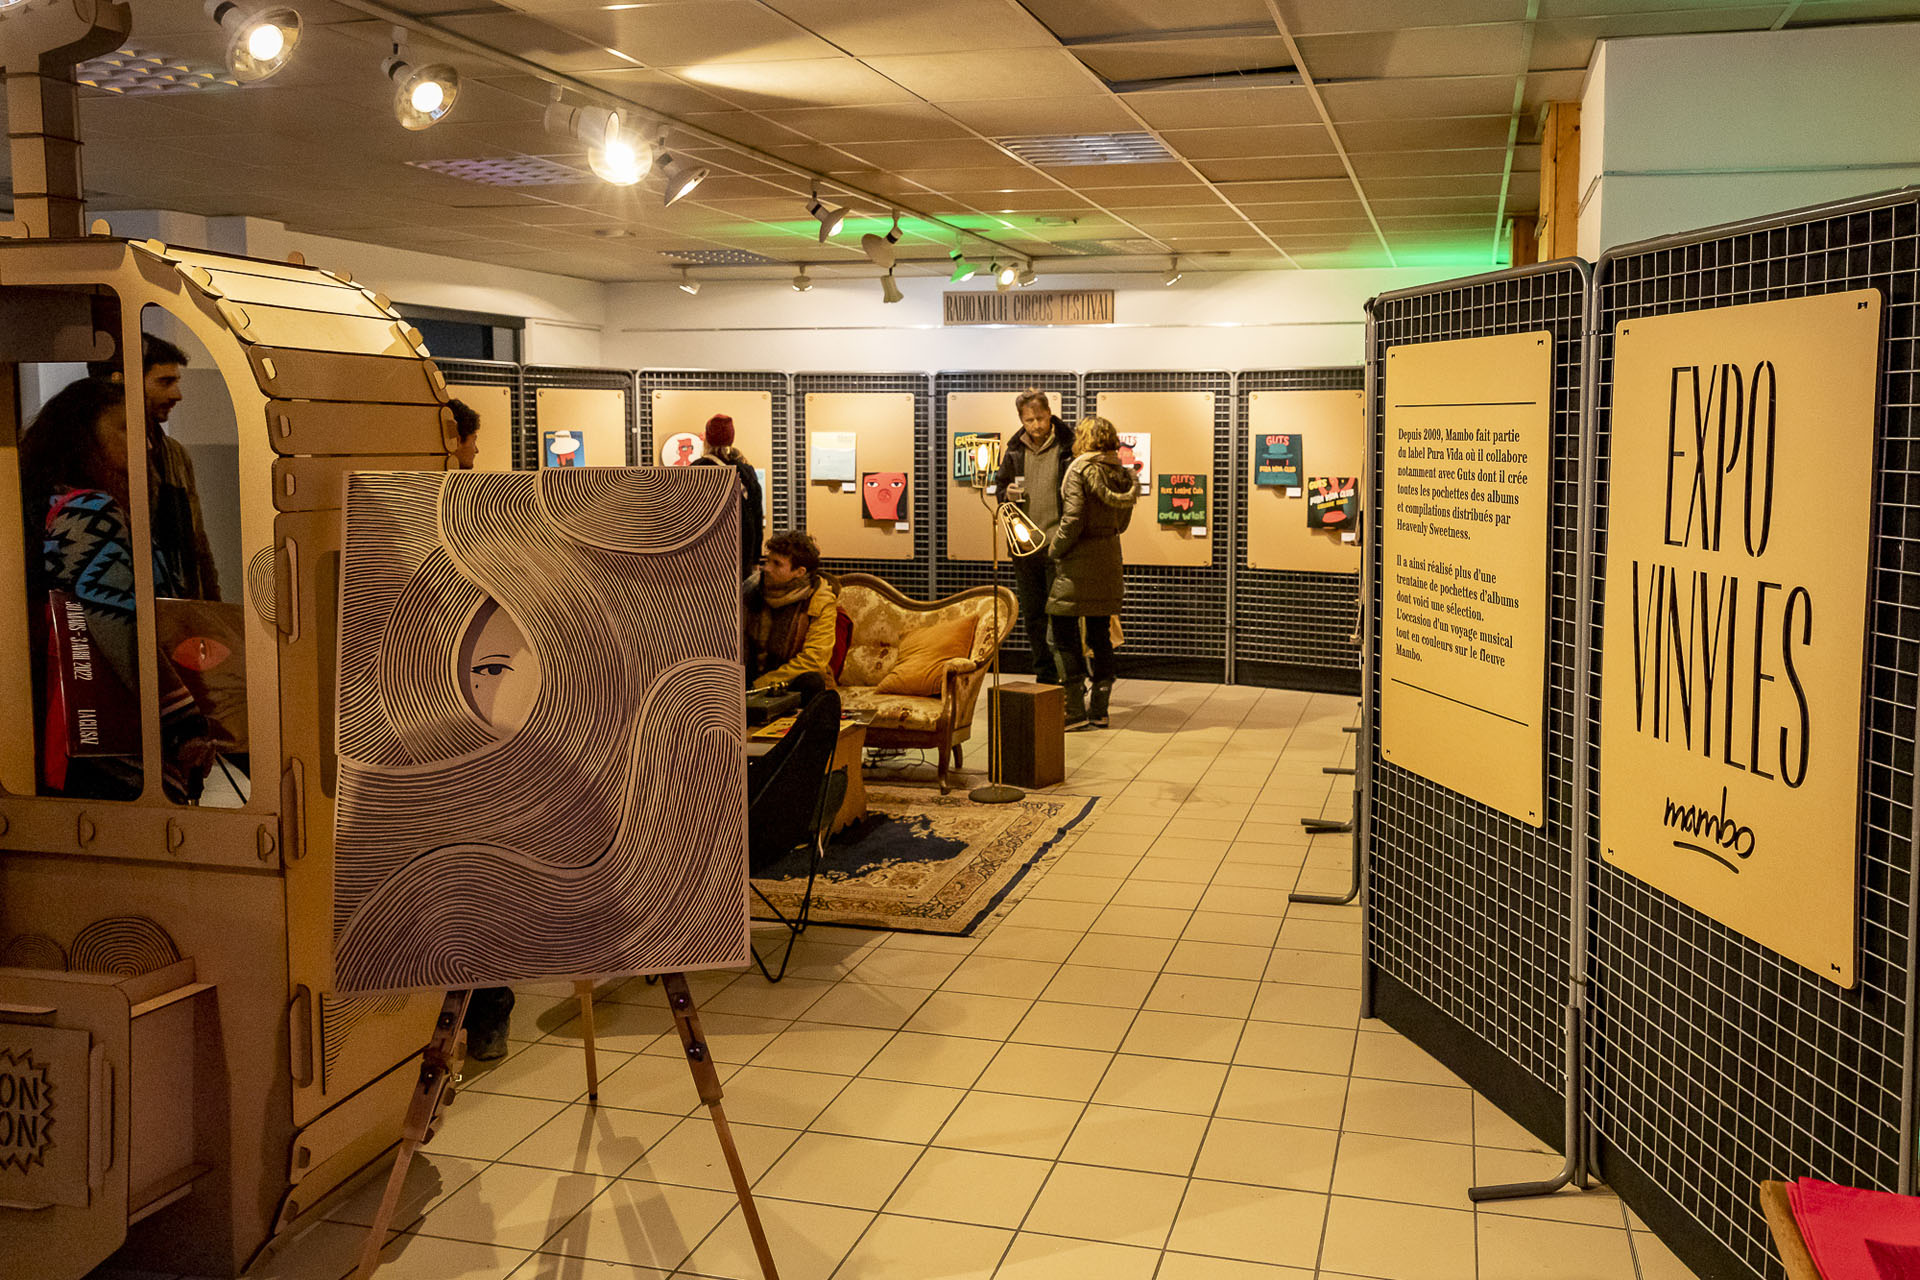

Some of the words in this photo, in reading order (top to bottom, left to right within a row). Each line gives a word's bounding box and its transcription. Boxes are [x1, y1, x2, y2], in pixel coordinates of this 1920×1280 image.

[946, 295, 975, 322] RADIO
[1013, 294, 1053, 321] CIRCUS
[1265, 435, 1290, 447] GUTS
[1398, 428, 1422, 443] Depuis
[1423, 428, 1444, 443] 2009,
[1445, 428, 1474, 441] Mambo
[1476, 428, 1491, 442] fait
[1493, 429, 1520, 445] partie
[1398, 447, 1406, 458] du
[1408, 447, 1425, 459] label
[1427, 447, 1444, 460] Pura
[1446, 448, 1463, 461] Vida
[1465, 448, 1475, 461] où
[1477, 449, 1484, 461] il
[1486, 449, 1528, 463] collabore
[1664, 360, 1778, 558] EXPO
[1170, 475, 1195, 485] GUTS
[1397, 466, 1436, 478] notamment
[1438, 469, 1455, 479] avec
[1457, 467, 1476, 481] Guts
[1477, 468, 1497, 483] dont
[1499, 469, 1505, 483] il
[1507, 470, 1528, 485] crée
[1397, 483, 1419, 495] toutes
[1420, 484, 1430, 497] les
[1432, 486, 1469, 500] pochettes
[1470, 488, 1485, 502] des
[1487, 490, 1519, 505] albums
[1397, 502, 1404, 513] et
[1405, 503, 1451, 518] compilations
[1452, 506, 1494, 523] distribués
[1495, 513, 1511, 527] par
[1397, 518, 1428, 536] Heavenly
[1429, 522, 1471, 540] Sweetness.
[1396, 554, 1402, 566] Il
[1403, 559, 1408, 567] a
[1409, 557, 1426, 571] ainsi
[1427, 560, 1453, 576] réalisé
[1454, 565, 1472, 580] plus
[1396, 573, 1428, 590] trentaine
[1429, 579, 1438, 592] de
[1440, 584, 1478, 600] pochettes
[65, 601, 84, 611] 30
[1396, 590, 1411, 604] dont
[1413, 595, 1429, 609] voici
[1431, 601, 1444, 612] une
[1446, 602, 1484, 622] sélection.
[67, 611, 87, 631] MARS
[1396, 626, 1410, 640] tout
[1411, 632, 1420, 643] en
[1421, 635, 1453, 652] couleurs
[1454, 644, 1468, 657] sur
[1470, 645, 1478, 659] le
[1479, 648, 1505, 667] fleuve
[1450, 624, 1478, 642] voyage
[1479, 631, 1513, 649] musical
[71, 643, 91, 660] AVRIL
[1395, 643, 1423, 662] Mambo.
[73, 661, 93, 681] 2022
[1632, 560, 1813, 789] VINYLES
[78, 709, 97, 719] LA
[79, 719, 99, 745] CLUSAZ
[1663, 786, 1756, 860] mambo
